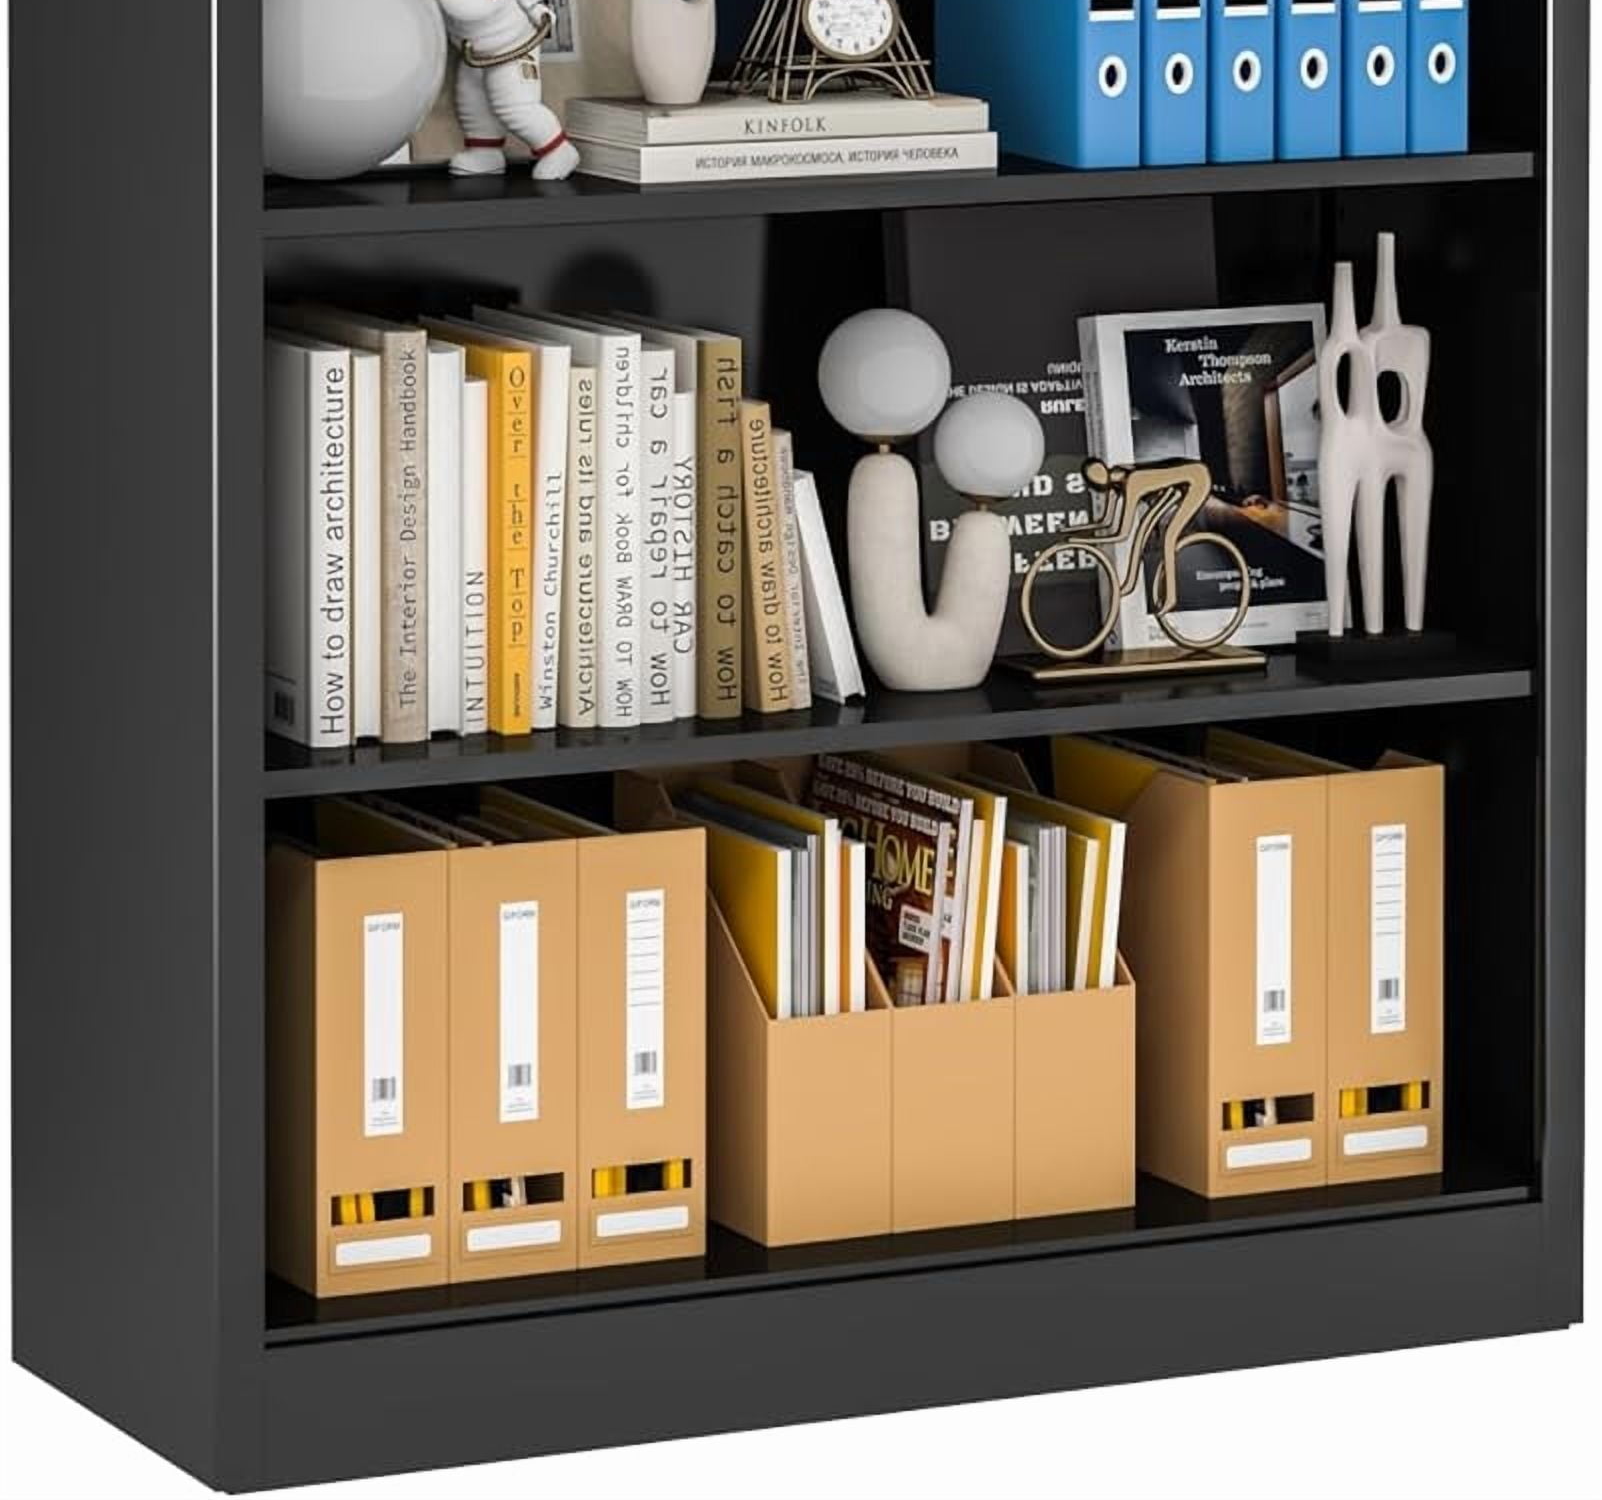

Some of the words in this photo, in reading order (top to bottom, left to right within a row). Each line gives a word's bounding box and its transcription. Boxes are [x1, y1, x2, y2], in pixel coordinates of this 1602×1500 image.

[695, 155, 748, 170] ИСТОРИЯ
[848, 149, 900, 164] ИСТОРИЯ
[901, 146, 960, 162] ЧЕЛОВЕКА
[743, 116, 828, 135] KINFOLK
[1164, 334, 1219, 354] Kerstin
[1179, 369, 1252, 387] Architects
[1197, 352, 1272, 369] Thompson
[400, 348, 418, 452] Handbook
[509, 365, 526, 454] Over
[320, 366, 345, 542] architecture
[400, 463, 421, 542] Design
[512, 484, 524, 546] the
[543, 470, 563, 597] Churchill
[320, 553, 345, 623] draw
[400, 554, 418, 657] Interior
[510, 567, 526, 645] Top
[321, 632, 345, 664] to
[465, 570, 485, 724] INTUITION
[538, 610, 558, 711] Winston
[320, 672, 345, 735] How
[400, 671, 418, 709] The
